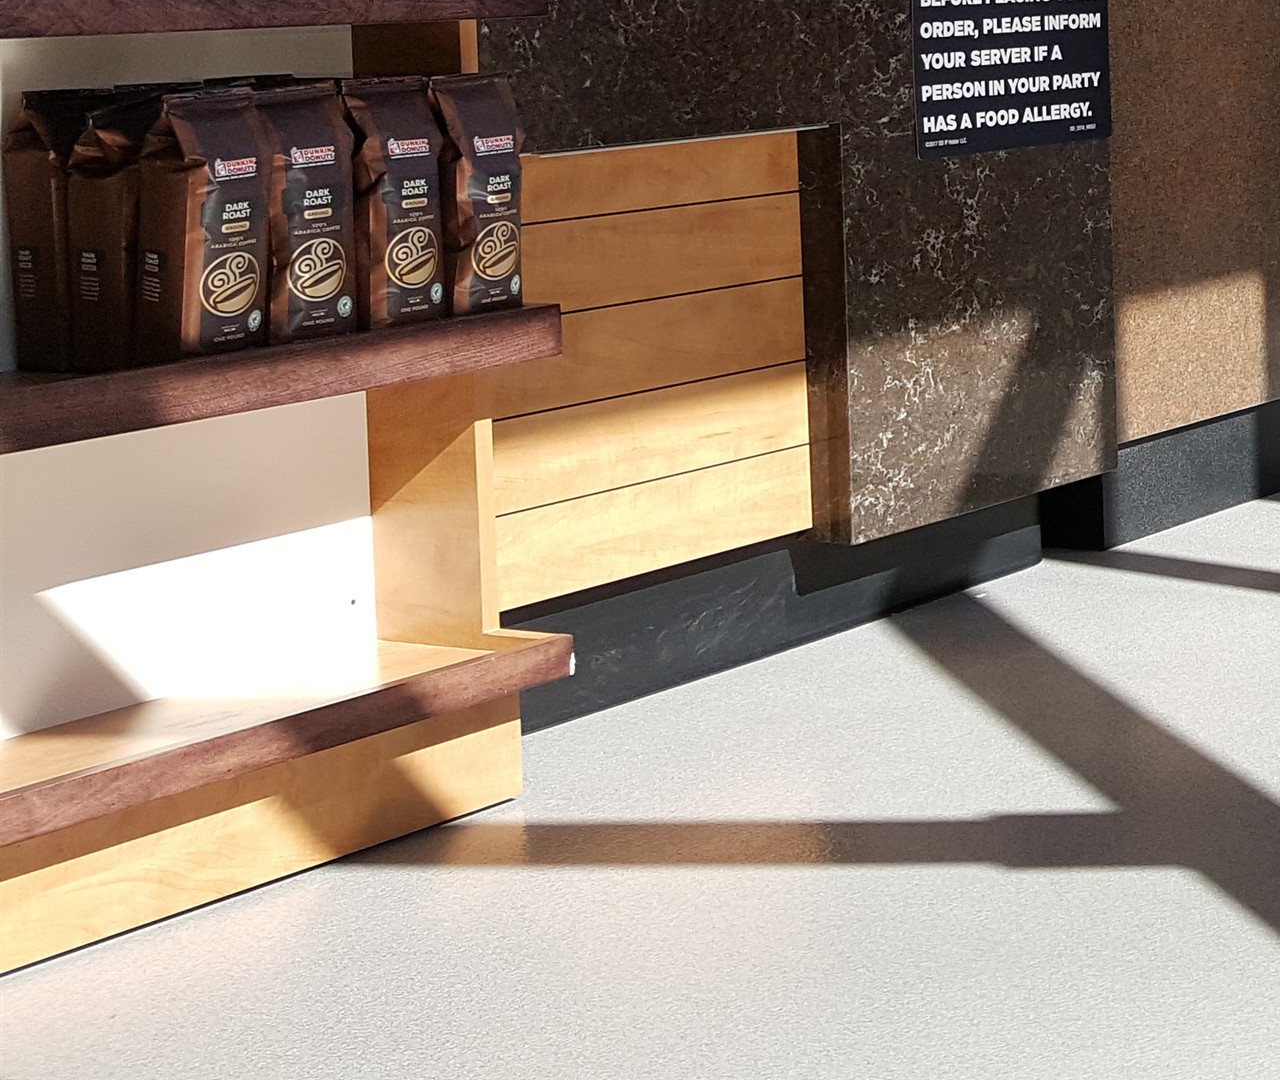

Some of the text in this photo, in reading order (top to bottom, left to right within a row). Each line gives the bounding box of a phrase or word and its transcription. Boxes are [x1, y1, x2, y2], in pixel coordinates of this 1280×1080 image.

[920, 13, 1101, 39] ORDER, PLEASE INFORM
[921, 45, 1063, 70] YOUR SERVER IF A
[922, 72, 1100, 102] PERSON IN YOUR PARTY
[923, 102, 1092, 134] HAS A FOOD ALLERGY.
[401, 144, 430, 153] DONUTS
[486, 140, 514, 150] DONUTS
[304, 152, 336, 162] DONUTS
[227, 165, 257, 176] DONUTS
[403, 179, 426, 188] DARK
[489, 174, 511, 184] DARK
[402, 186, 429, 196] ROAST
[486, 182, 512, 192] ROAST
[305, 188, 330, 198] DARK
[304, 196, 332, 206] ROAST
[225, 202, 249, 212] DARK
[222, 210, 251, 220] ROAST
[392, 216, 418, 224] ARABICA
[294, 228, 320, 236] ARABICA
[210, 240, 236, 249] ARABICA
